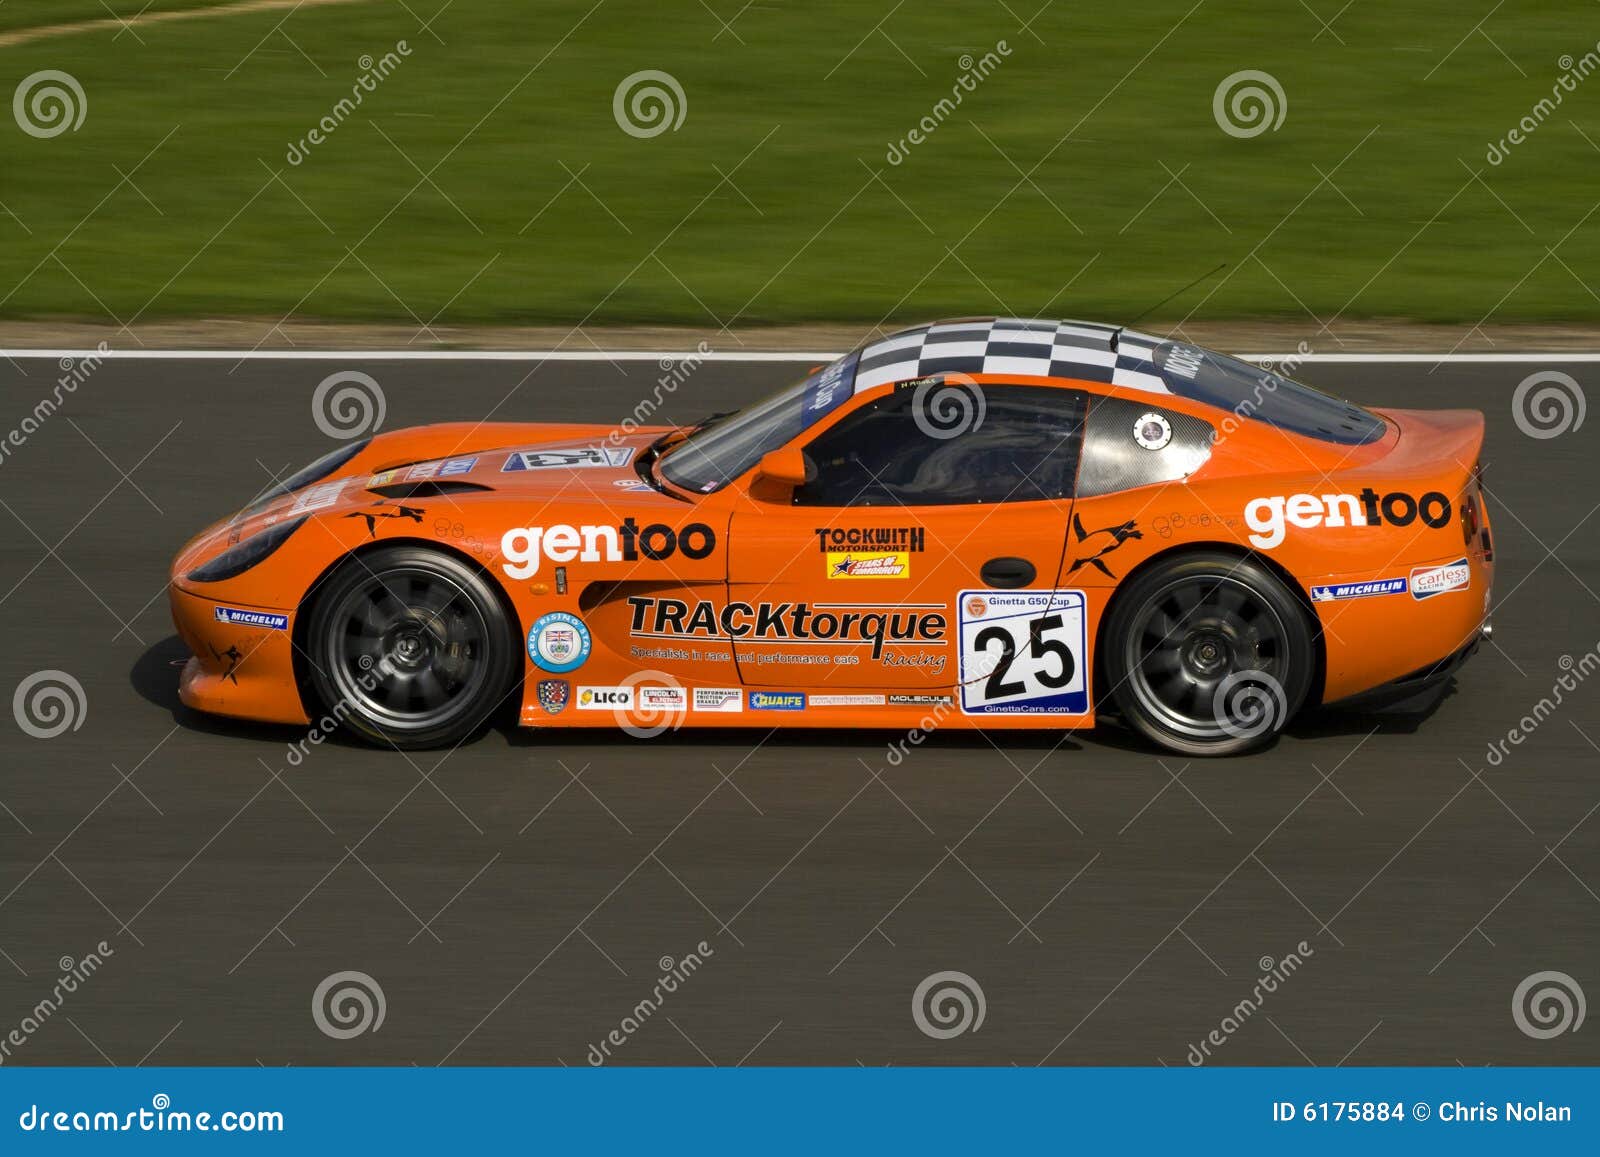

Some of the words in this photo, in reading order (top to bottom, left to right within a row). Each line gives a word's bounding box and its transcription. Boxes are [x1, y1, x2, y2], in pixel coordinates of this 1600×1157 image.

[1244, 488, 1452, 550] gentoo
[501, 518, 716, 580] gentoo
[815, 527, 925, 552] TOCKWITH
[1417, 567, 1467, 586] carless
[1336, 581, 1403, 596] MICHELIN
[989, 597, 1026, 606] Ginetta
[1028, 597, 1048, 606] G50
[1050, 597, 1070, 607] Cup
[231, 612, 285, 626] MICHELIN
[627, 596, 947, 660] TRACKtorque
[630, 645, 690, 660] Specialists
[692, 650, 702, 660] in
[736, 651, 755, 663] and
[757, 652, 831, 665] performance
[834, 654, 859, 665] cars
[881, 651, 947, 675] Racing
[974, 614, 1075, 701] 25
[594, 692, 629, 704] LICO
[758, 694, 803, 706] QUAIFE
[889, 695, 951, 703] MOLECULE
[984, 705, 1070, 714] GinettaCars.com
